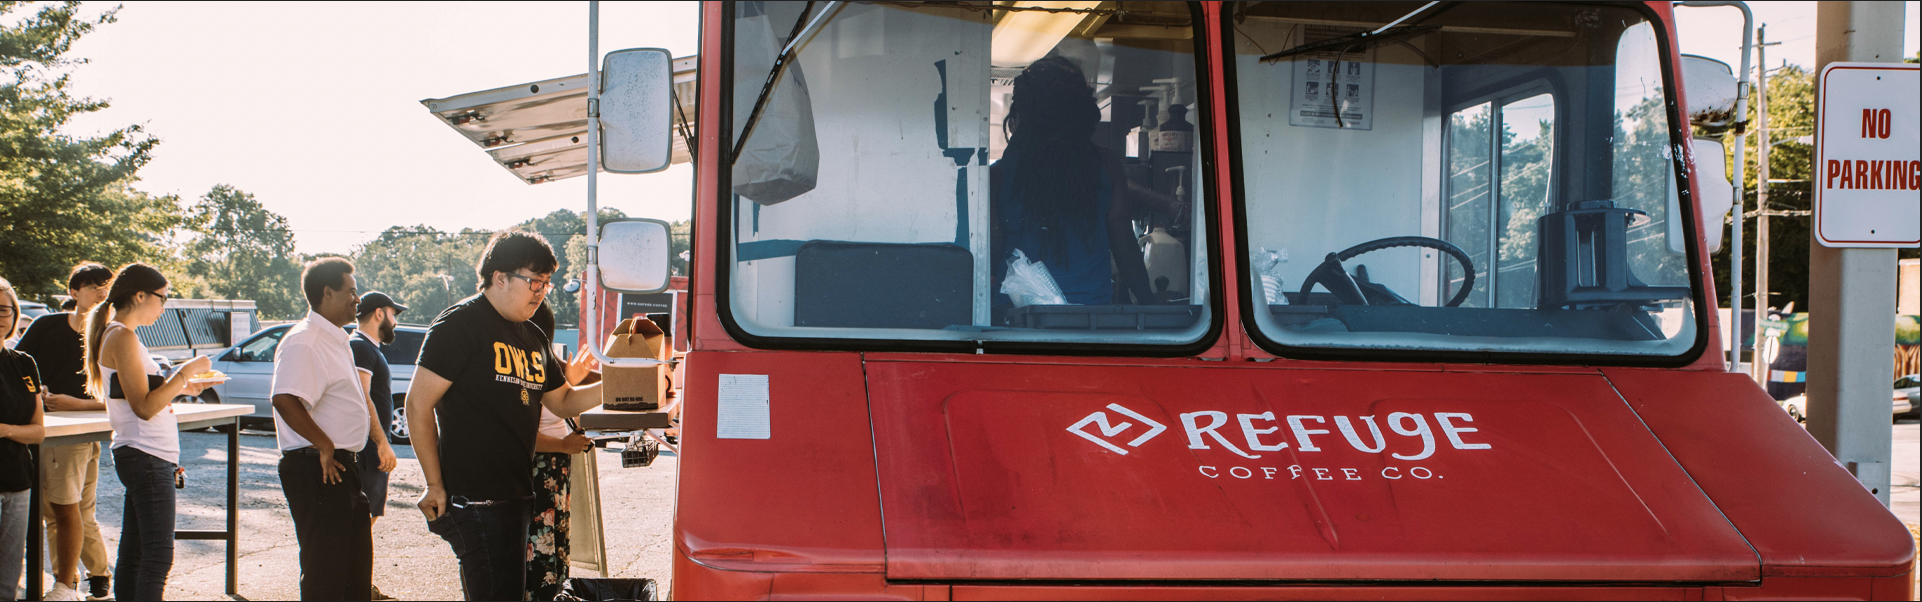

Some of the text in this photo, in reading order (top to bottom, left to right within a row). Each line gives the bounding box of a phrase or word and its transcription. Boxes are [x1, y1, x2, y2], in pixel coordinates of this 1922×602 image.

[1861, 108, 1891, 140] NO
[1826, 159, 1921, 191] PARKING
[493, 341, 546, 383] OWLS
[1180, 410, 1492, 461] REFUGE
[1199, 464, 1444, 481] COFFEE CO.
